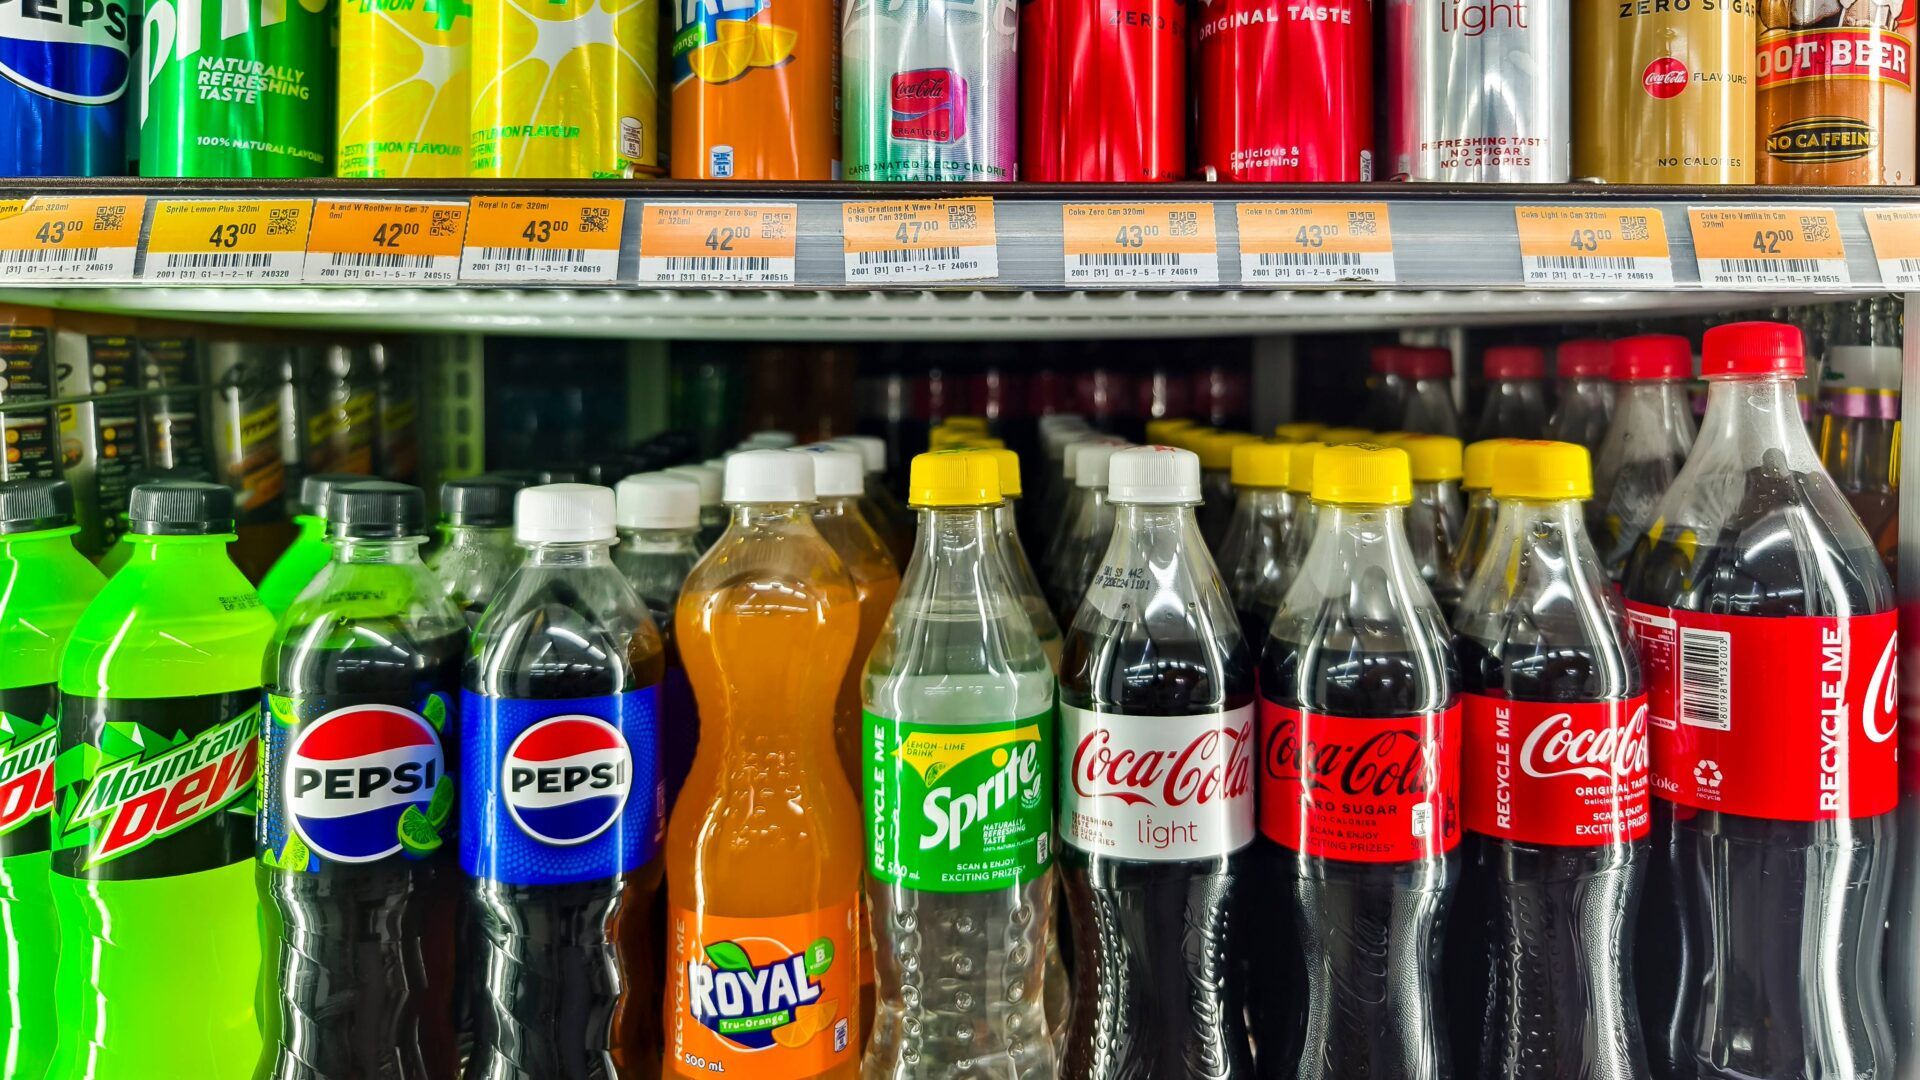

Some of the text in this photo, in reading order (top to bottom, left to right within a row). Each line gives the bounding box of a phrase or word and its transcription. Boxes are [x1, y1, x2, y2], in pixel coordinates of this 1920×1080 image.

[1288, 6, 1352, 26] TASTE
[1442, 0, 1528, 37] light
[1619, 0, 1691, 19] ZERO
[0, 0, 127, 42] EPS
[1756, 39, 1907, 78] OOT BEER
[198, 55, 304, 83] NATURALLY
[1693, 72, 1748, 85] FLAVOURS
[197, 71, 309, 100] REFRESHING
[198, 85, 258, 104] TASTE
[894, 78, 946, 99] Coca-Cola
[894, 128, 947, 139] CREATIONS
[1766, 131, 1879, 150] NO CAFFEINE
[197, 136, 285, 155] 100% NATURAL
[1230, 148, 1287, 161] Delicious
[1450, 147, 1521, 158] NO SUGAR
[1230, 157, 1300, 170] Refreshing
[1440, 160, 1459, 169] NO
[1658, 158, 1678, 167] NO
[166, 206, 189, 214] Sprite
[478, 201, 499, 210] Royal
[1820, 627, 1842, 811] RECYCLE ME
[1519, 703, 1649, 781] Coca-Co
[906, 748, 933, 758] DRINK
[78, 711, 259, 819] Mountain
[1071, 720, 1251, 808] Coca-Cola
[1496, 707, 1511, 829] RECYCLE ME
[293, 757, 436, 800] PEPSI
[511, 758, 626, 794] PEPSI
[1651, 772, 1679, 793] Coke
[873, 724, 886, 872] RECYCLE ME
[919, 742, 1038, 851] Sprite
[1697, 786, 1720, 795] please
[1342, 803, 1398, 815] SUGAR
[983, 818, 1024, 831] NATURALLY
[1138, 814, 1199, 849] light
[983, 836, 1006, 845] TASTE
[1346, 830, 1380, 840] ENJOY
[957, 862, 980, 871] SCAN
[990, 858, 1015, 869] ENJOY
[942, 873, 990, 882] EXCITING
[675, 918, 685, 1060] RECYCLE ME
[689, 955, 820, 1017] ROYAL
[685, 1053, 725, 1072] 500 mL
